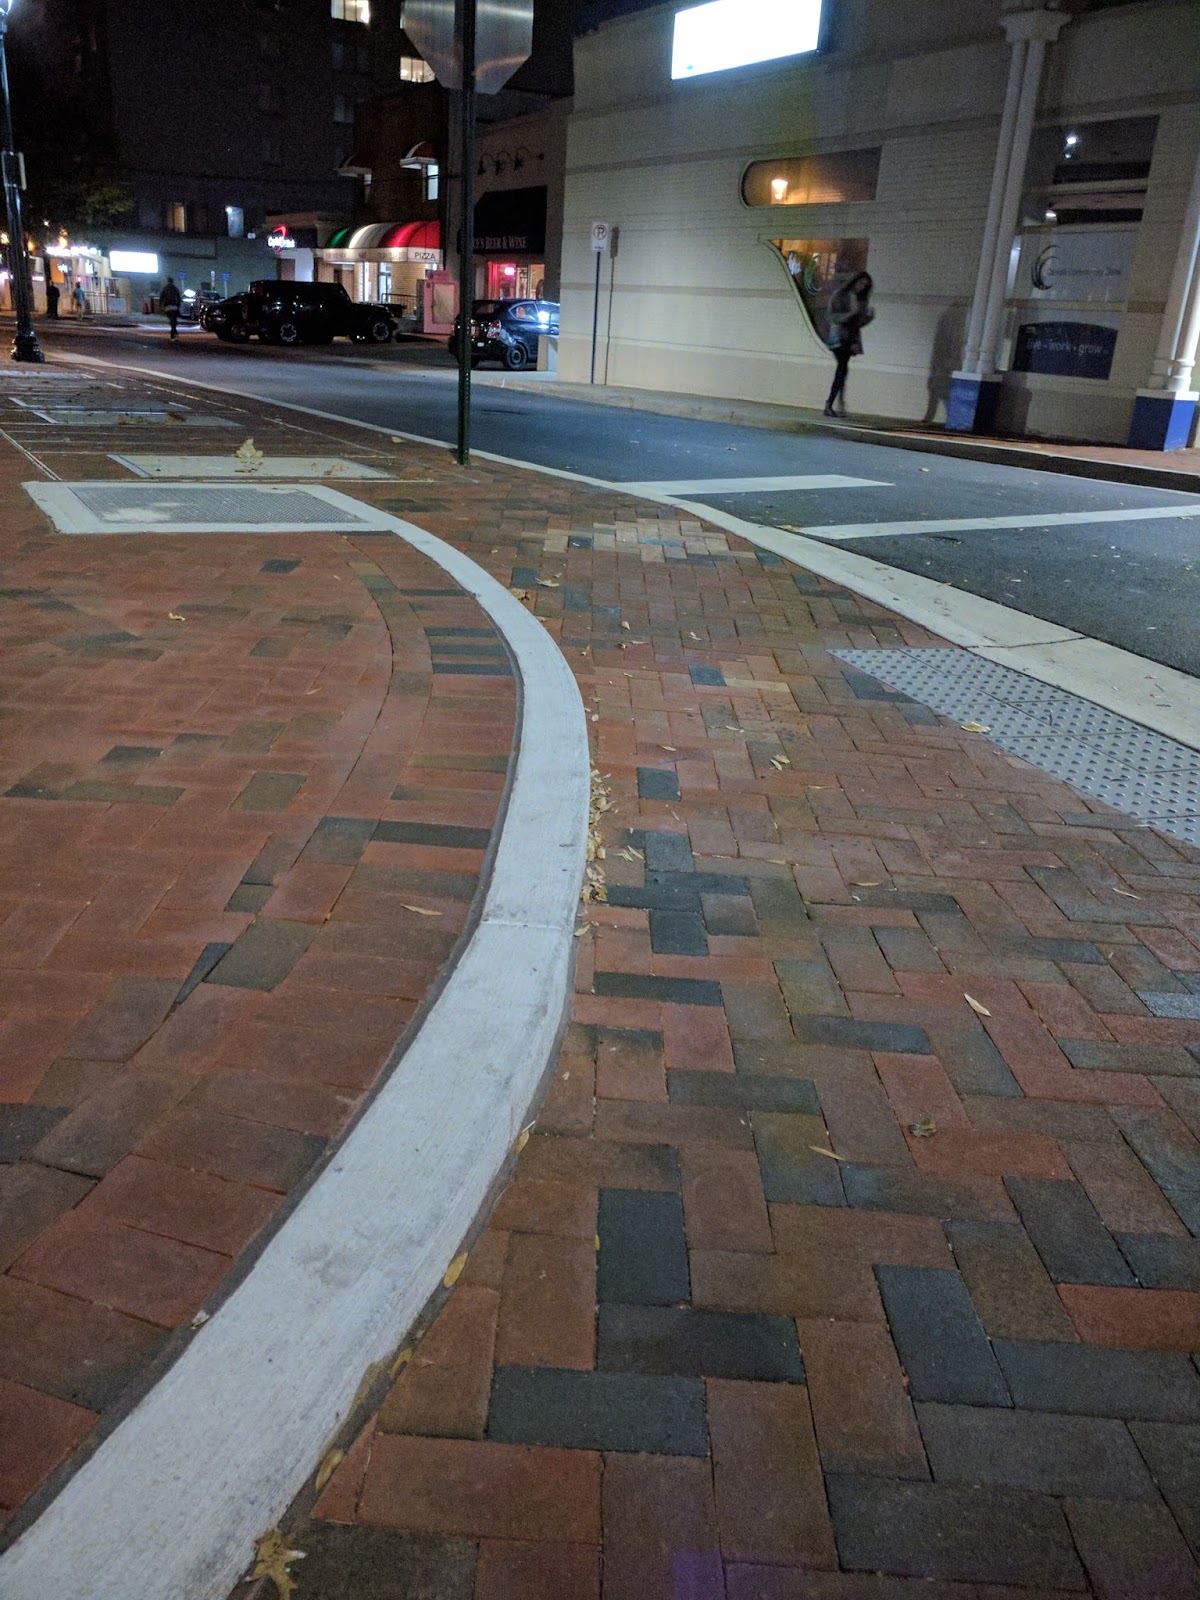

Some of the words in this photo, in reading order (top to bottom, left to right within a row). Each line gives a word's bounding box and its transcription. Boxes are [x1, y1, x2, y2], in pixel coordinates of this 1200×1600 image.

[510, 234, 528, 249] WINE
[414, 251, 436, 260] PIZZA
[1048, 340, 1072, 353] work
[1078, 343, 1104, 357] grow
